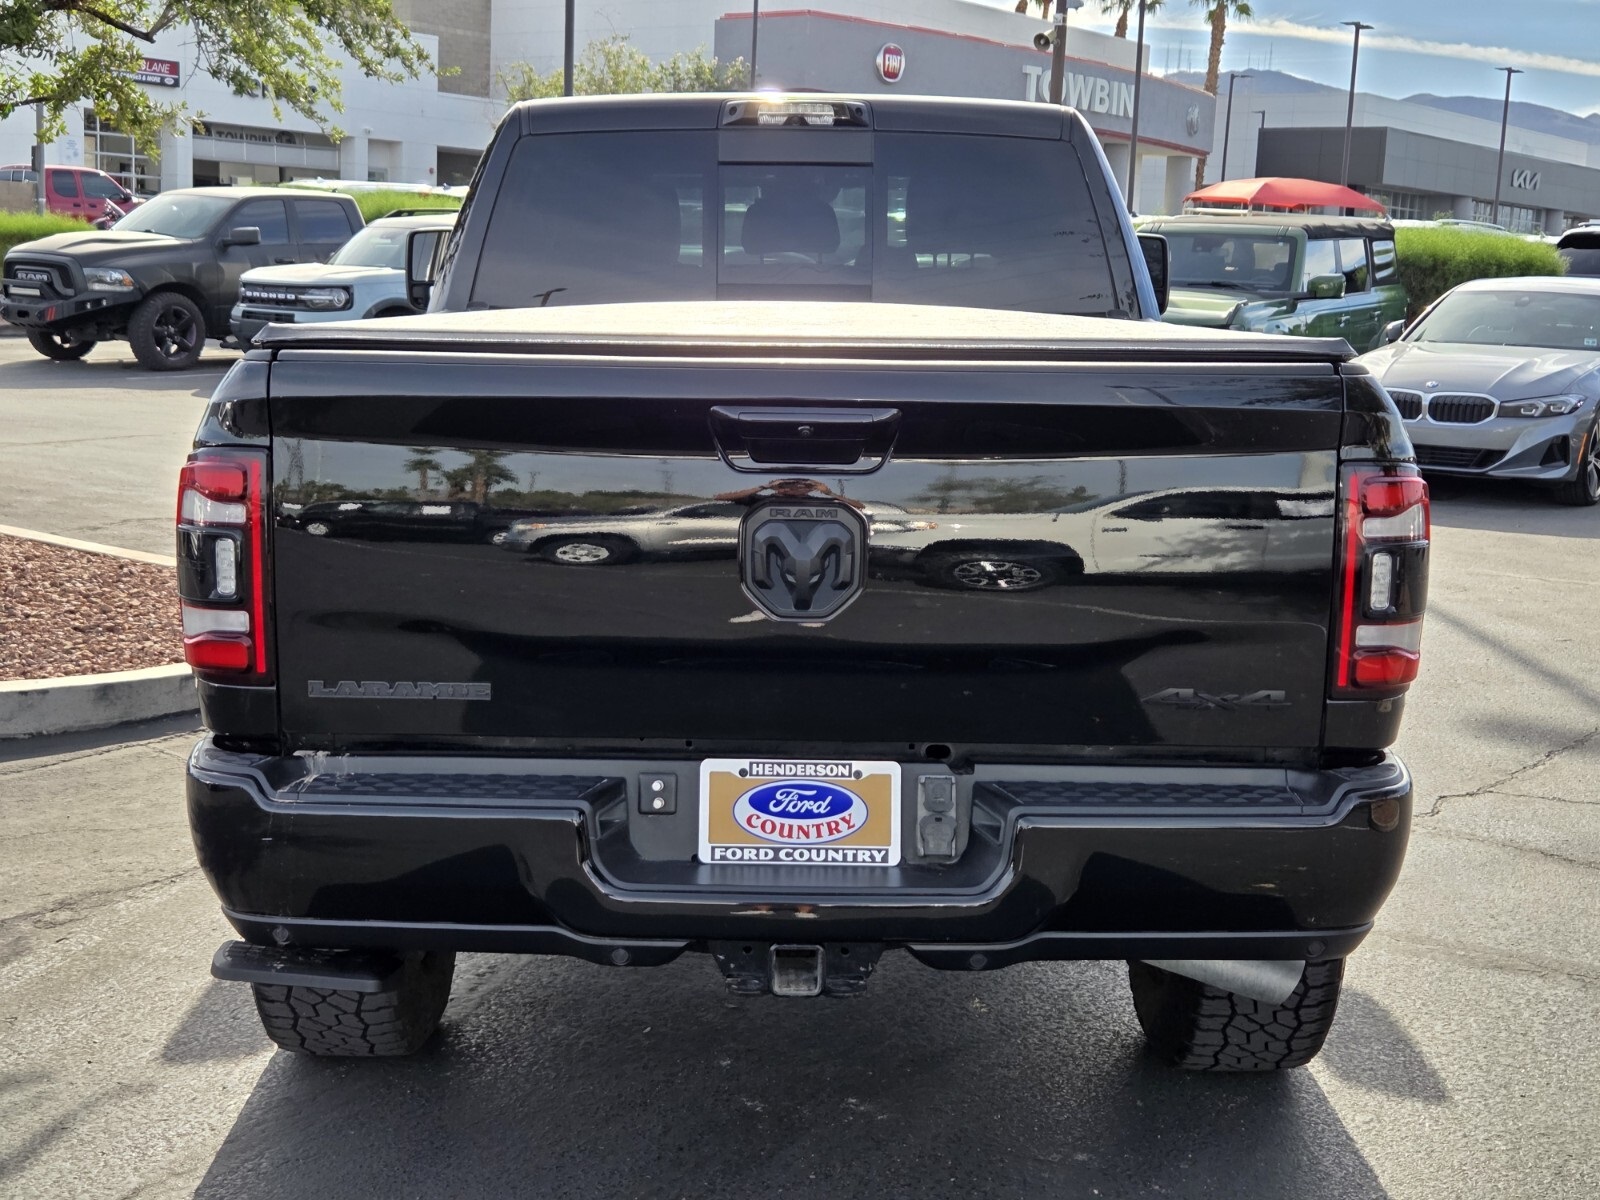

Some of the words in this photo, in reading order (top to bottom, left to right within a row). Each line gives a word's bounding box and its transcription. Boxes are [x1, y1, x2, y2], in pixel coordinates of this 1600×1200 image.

[885, 53, 900, 73] FIAT
[1512, 168, 1541, 190] KIA
[17, 272, 47, 281] RAM
[245, 291, 296, 300] BRONCO
[769, 508, 838, 518] RAM
[308, 680, 491, 700] LARAMIE
[751, 763, 850, 777] HENDERSON
[769, 788, 833, 814] Ford
[746, 813, 856, 839] COUNTRY
[714, 847, 774, 861] FORD
[779, 848, 887, 862] COUNTRY
